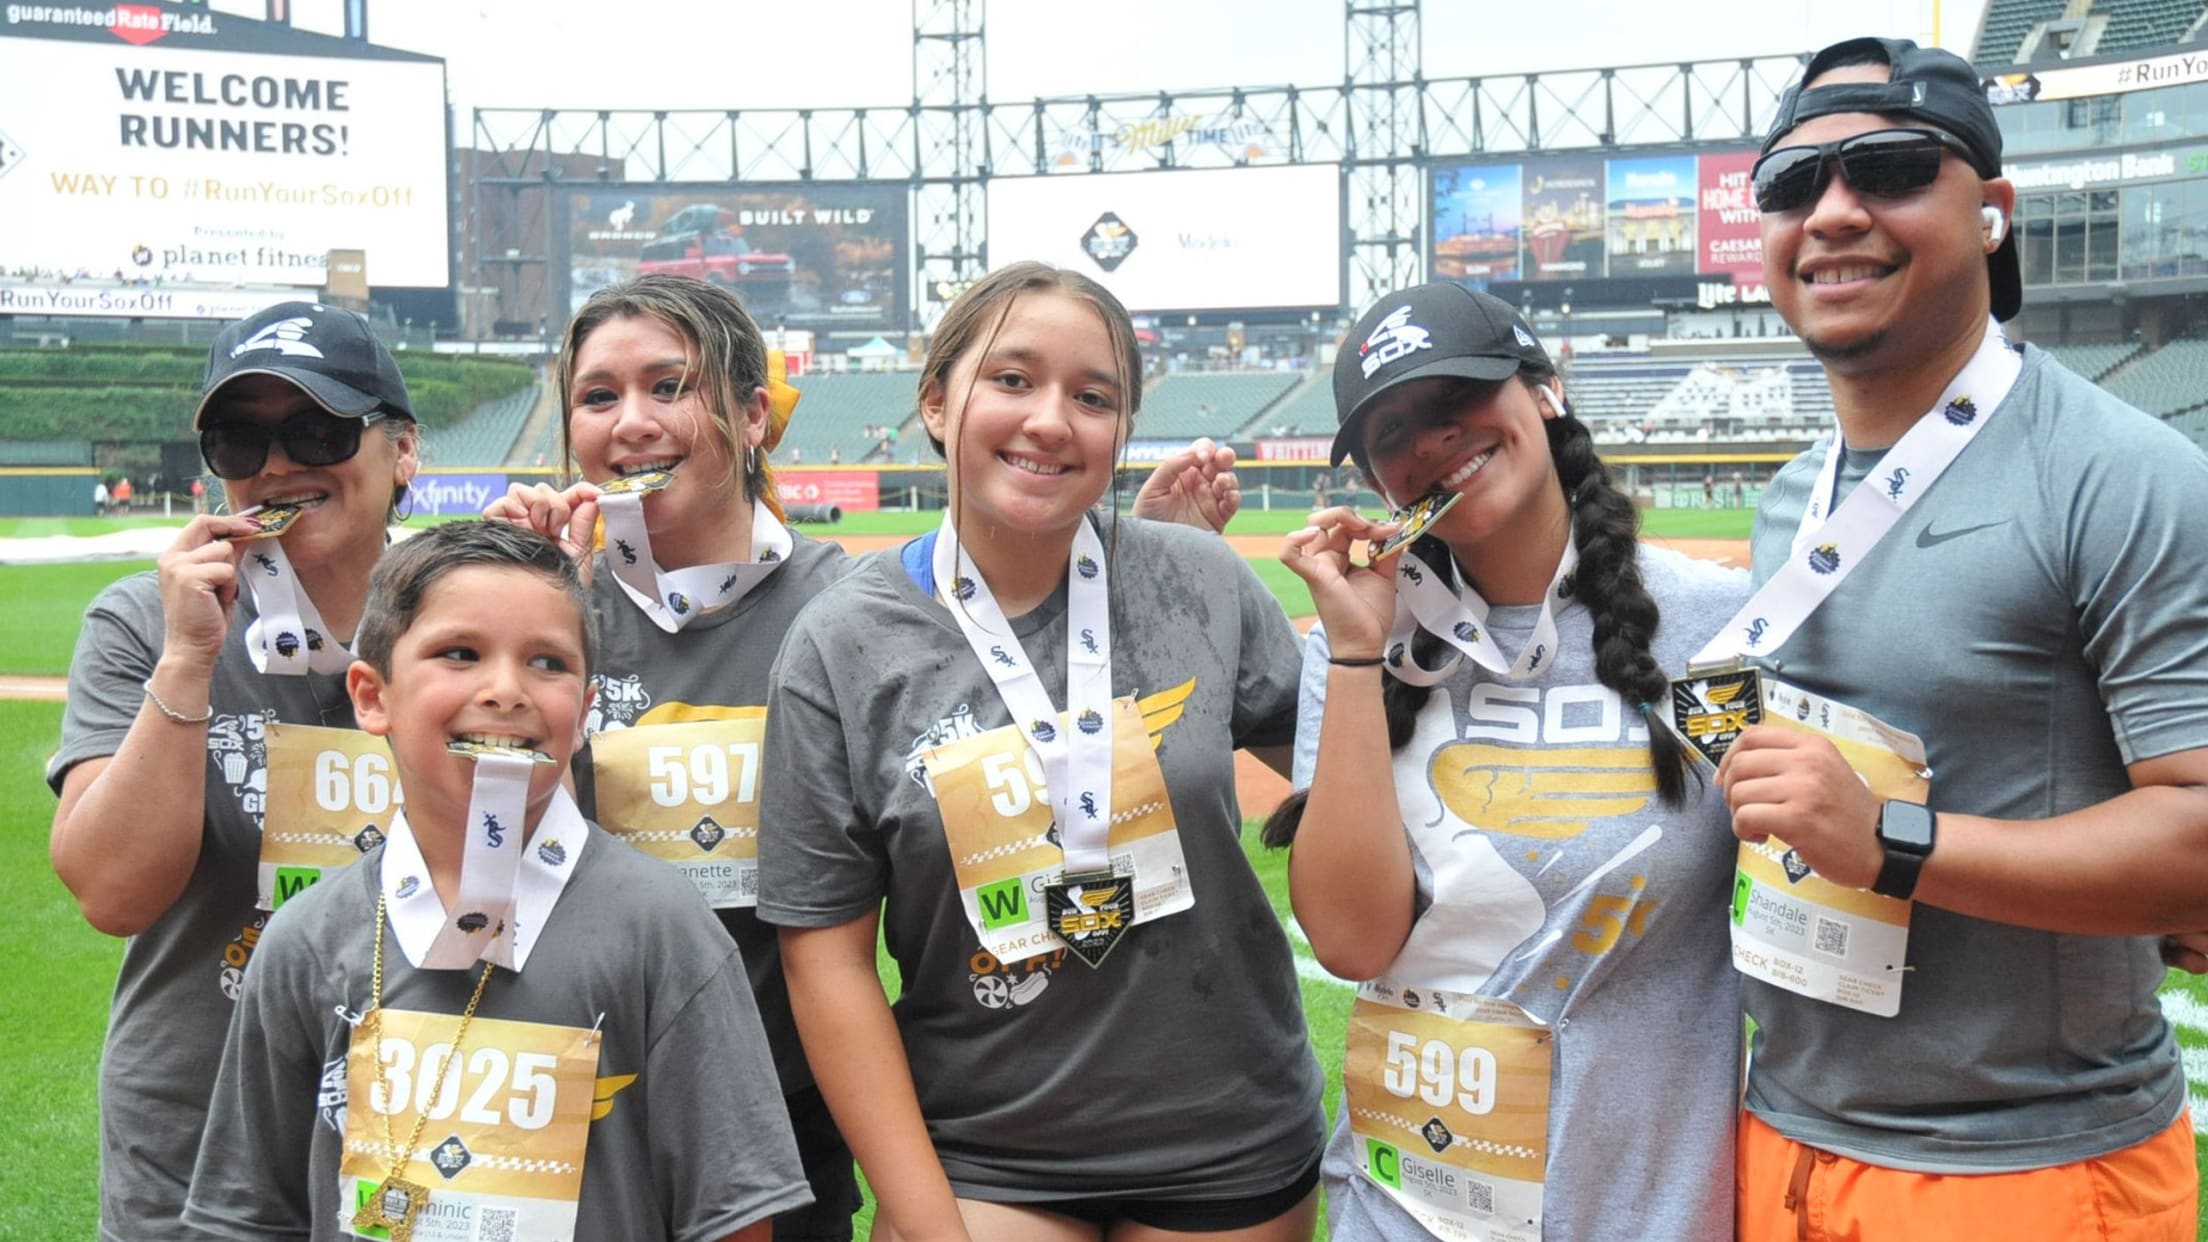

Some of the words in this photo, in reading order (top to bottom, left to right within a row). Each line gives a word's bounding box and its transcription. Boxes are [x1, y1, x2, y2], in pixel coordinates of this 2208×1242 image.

[7, 4, 116, 27] guaranteed
[117, 8, 160, 31] Rate
[115, 67, 350, 112] WELCOME
[119, 114, 350, 156] RUNNERS!
[1113, 114, 1204, 156] Miller
[1187, 127, 1228, 145] TIME
[1719, 172, 1748, 188] HIT
[2003, 159, 2119, 189] Huntington
[2121, 151, 2175, 179] Bank
[51, 172, 118, 197] WAY
[129, 175, 169, 199] TO
[183, 178, 414, 208] #RunYourSoxOff
[1702, 188, 1745, 210] HOME
[738, 210, 805, 226] BUILT
[813, 209, 872, 225] WILD
[163, 245, 248, 268] planet
[412, 480, 491, 516] xfinity
[605, 677, 644, 702] 5K
[1686, 708, 1750, 737] SOX
[648, 741, 759, 808] 597
[981, 886, 1020, 921] W
[1750, 888, 1808, 926] Shandale
[1061, 909, 1122, 936] SOX
[369, 1037, 558, 1131] 3025
[1384, 1029, 1497, 1116] 599
[1374, 1146, 1394, 1182] C
[1402, 1156, 1455, 1188] Giselle
